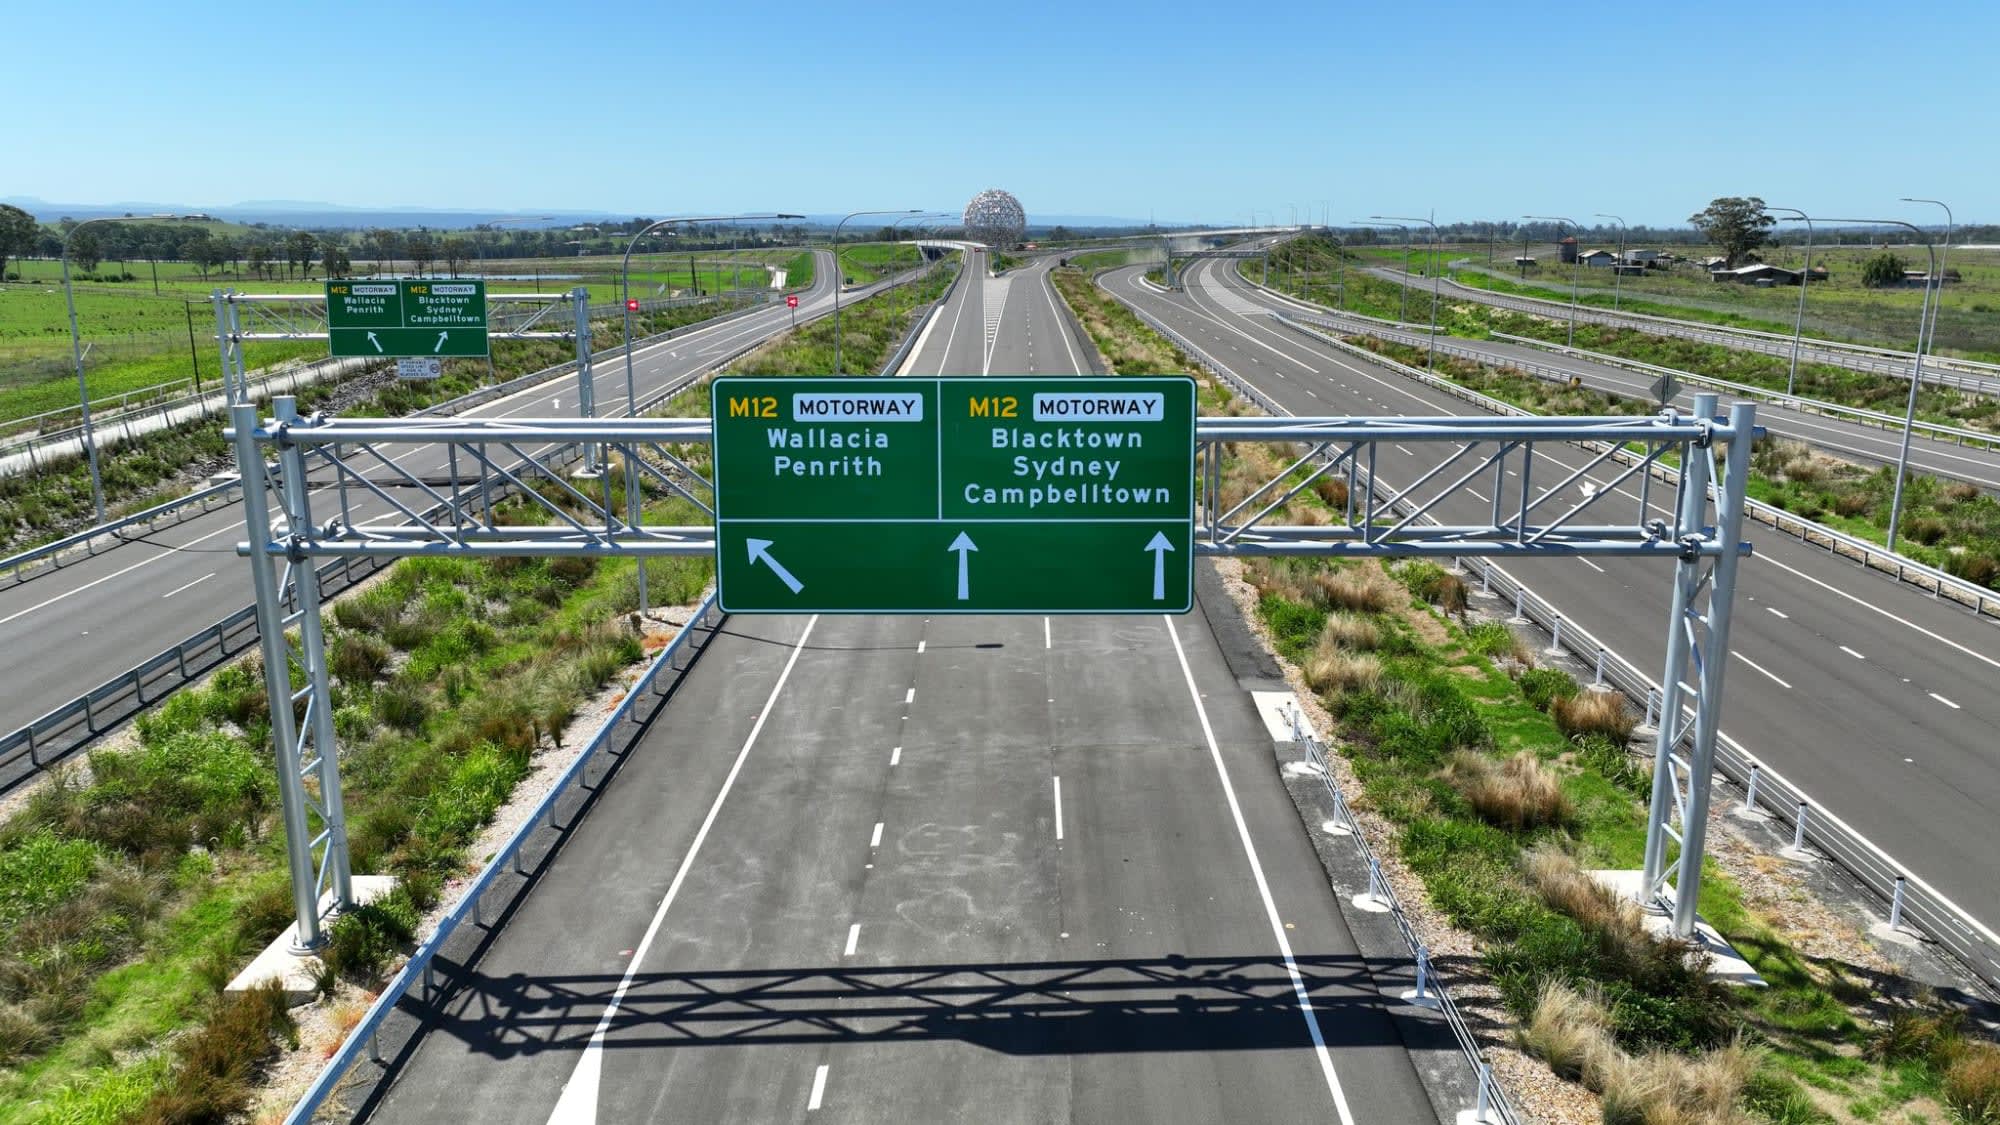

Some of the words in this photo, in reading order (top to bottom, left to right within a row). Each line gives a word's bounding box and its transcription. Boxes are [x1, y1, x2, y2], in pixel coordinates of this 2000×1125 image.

[331, 286, 348, 294] M12
[410, 286, 428, 294] M12
[343, 297, 386, 305] Wallacia
[419, 296, 470, 304] Blacktown
[346, 306, 384, 314] Penrith
[426, 306, 463, 315] Sydney
[410, 314, 480, 324] Campbelltown
[729, 396, 778, 418] M12
[799, 399, 916, 416] MOTORWAY
[969, 396, 1018, 418] M12
[1039, 399, 1157, 415] MOTORWAY
[767, 427, 889, 449] Wallacia
[992, 427, 1142, 448] Blacktown
[774, 455, 882, 476] Penrith
[1013, 455, 1121, 481] Sydney
[964, 483, 1170, 509] Campbelltown
